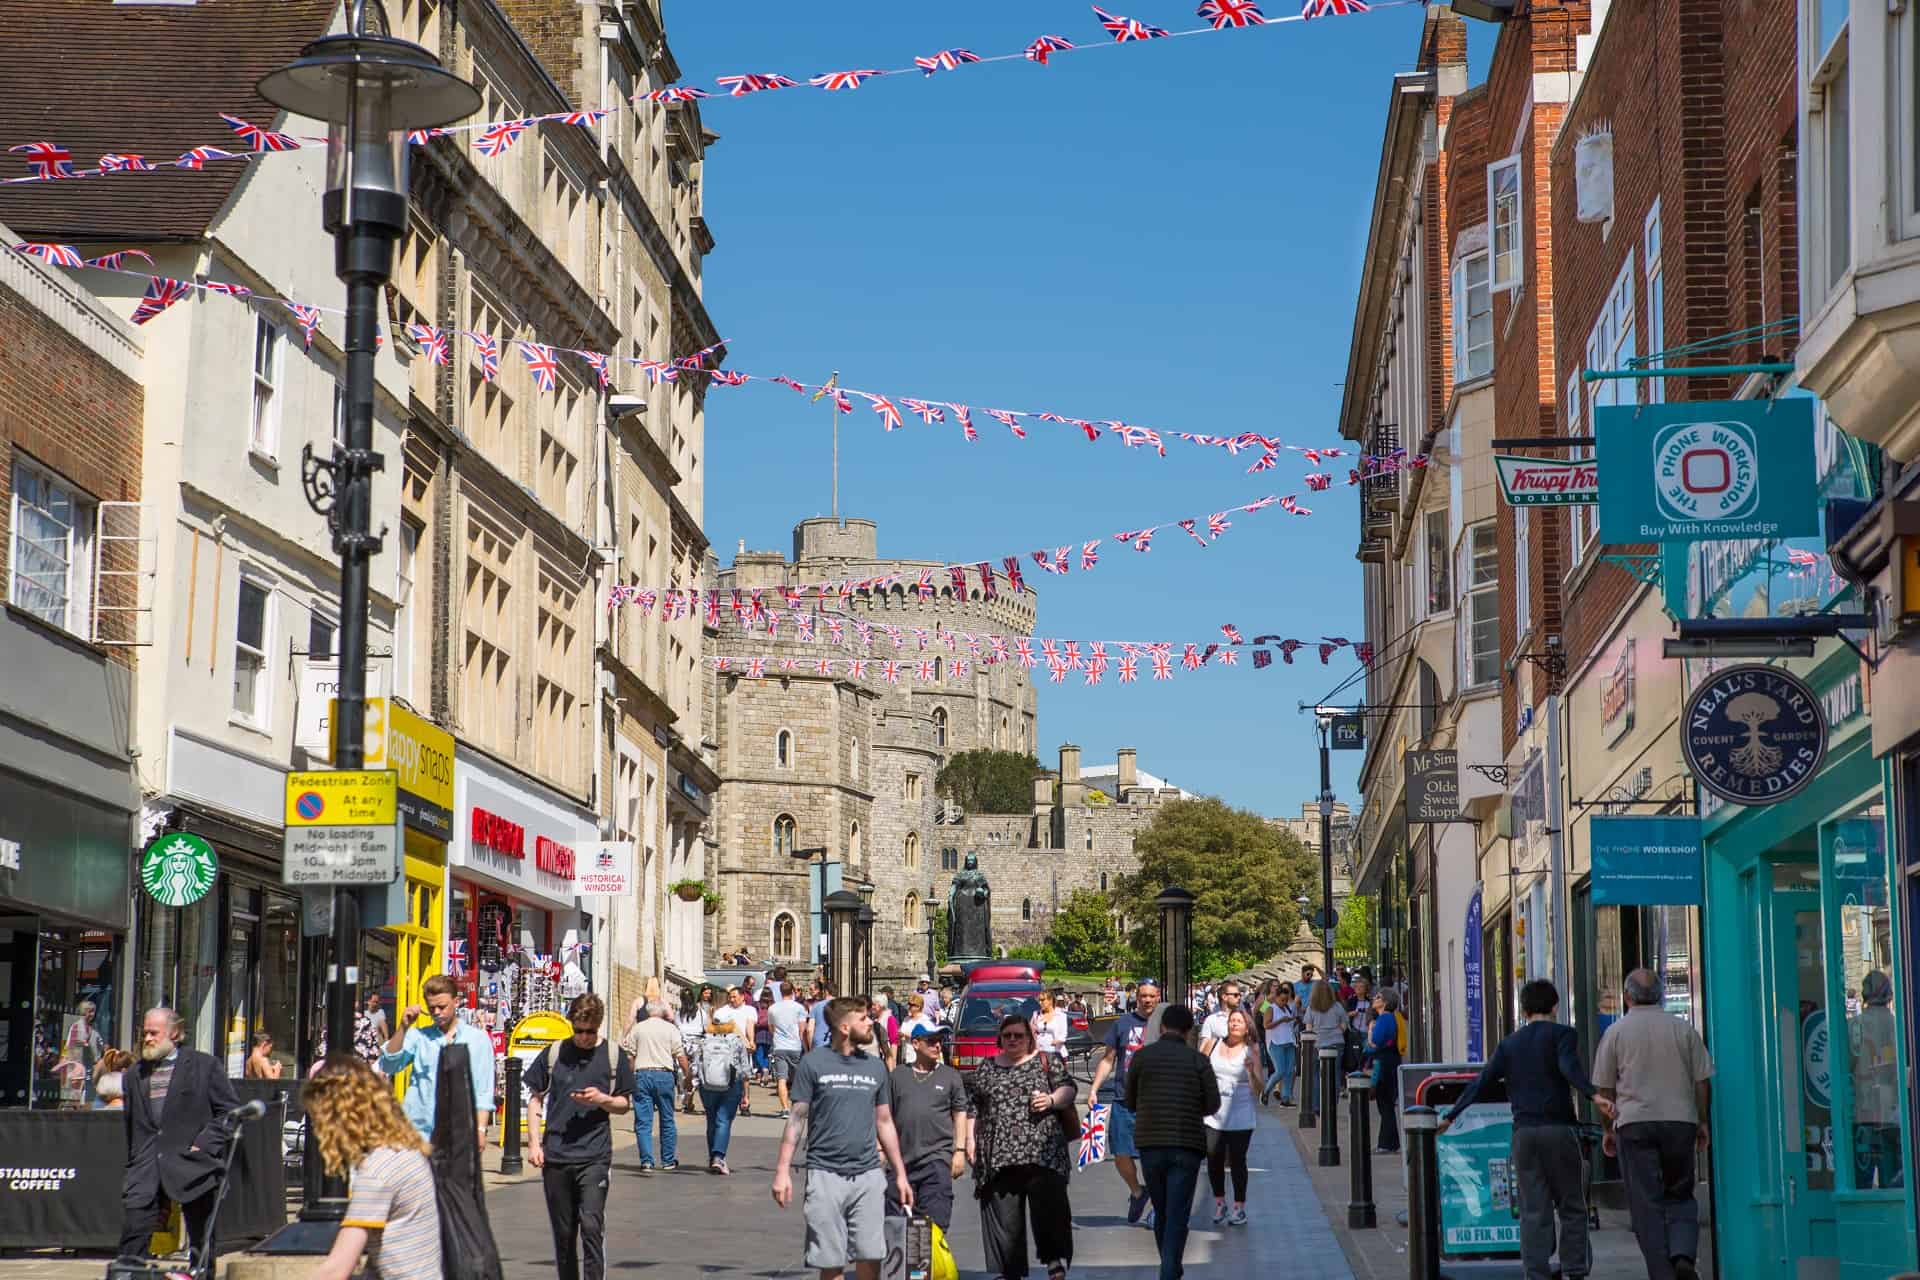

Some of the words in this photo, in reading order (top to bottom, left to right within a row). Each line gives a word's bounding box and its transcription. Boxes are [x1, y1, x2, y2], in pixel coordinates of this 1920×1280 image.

[1662, 431, 1700, 477] PHONE
[1712, 430, 1750, 510] WORKSHOP
[1511, 467, 1571, 491] Krispy
[1514, 494, 1599, 503] DOUGHN
[1669, 486, 1697, 511] THE
[1640, 525, 1664, 537] Buy
[1668, 522, 1700, 534] With
[1704, 521, 1778, 534] Knowledge
[1692, 673, 1755, 731] NEAL'S
[1765, 676, 1815, 724] YARD
[1336, 724, 1358, 739] fix
[1693, 735, 1735, 745] COVENT
[1773, 732, 1816, 742] GARDEN
[1413, 755, 1431, 775] Mr
[1699, 747, 1814, 795] REMEDIES
[290, 777, 358, 787] Pedestrian
[361, 776, 393, 786] Zone
[1427, 780, 1456, 792] Olde
[343, 795, 357, 805] At
[361, 797, 383, 806] any
[349, 809, 376, 817] time
[307, 830, 325, 839] No
[329, 829, 374, 840] loading
[293, 843, 347, 853] Midght
[1642, 846, 1697, 854] WORKSHOP
[332, 869, 387, 882] Midnight
[581, 873, 625, 883] HISTORICAL
[584, 883, 623, 892] WINDSOR
[0, 1168, 76, 1179] STARBUCKS
[10, 1179, 61, 1190] COFFEE
[1456, 1228, 1472, 1241] NO
[1497, 1227, 1513, 1241] NO
